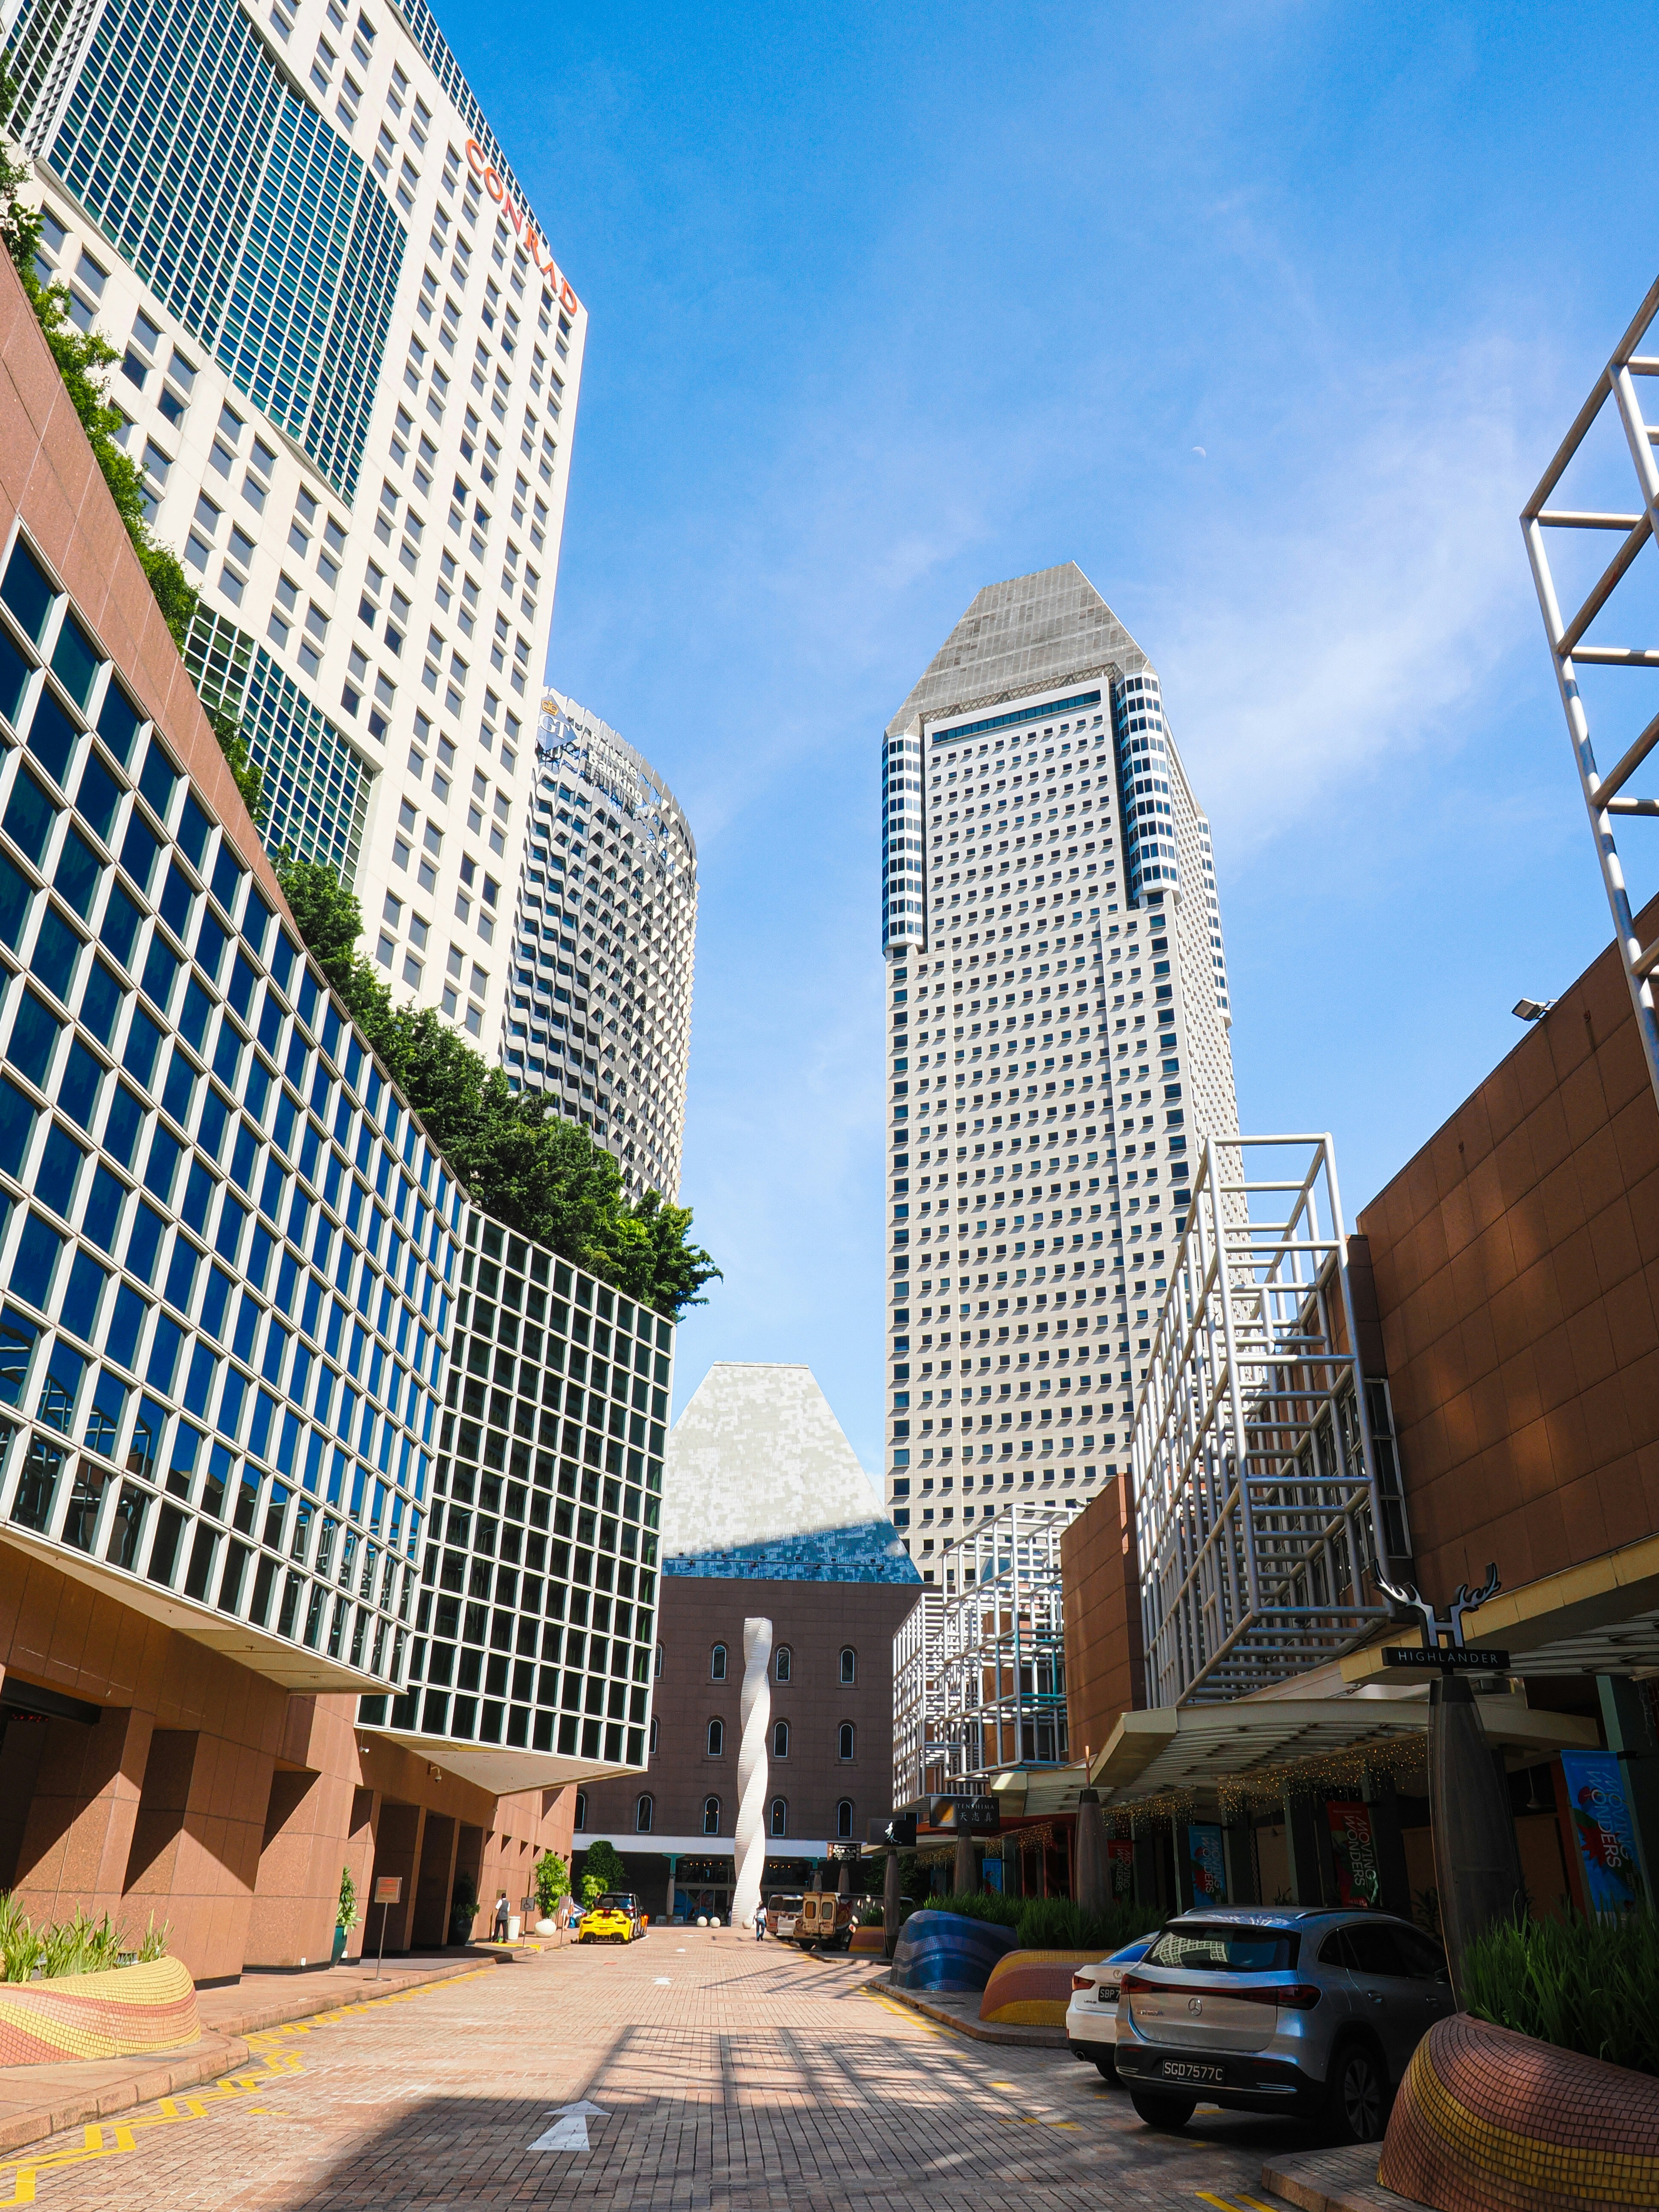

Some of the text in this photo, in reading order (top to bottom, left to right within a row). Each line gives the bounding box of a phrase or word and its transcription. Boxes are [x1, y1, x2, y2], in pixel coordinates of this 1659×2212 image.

[465, 138, 577, 317] CONRAD
[1398, 1651, 1498, 1664] HIGHLANDER
[1586, 1770, 1622, 1868] WONDERS
[1602, 1771, 1635, 1860] MOVING
[1115, 1848, 1124, 1892] WONDERS
[1123, 1849, 1131, 1889] MOVING
[1344, 1816, 1365, 1886] WONDERS
[1355, 1816, 1377, 1880] MOVING
[1164, 2062, 1223, 2081] SGD7577C
